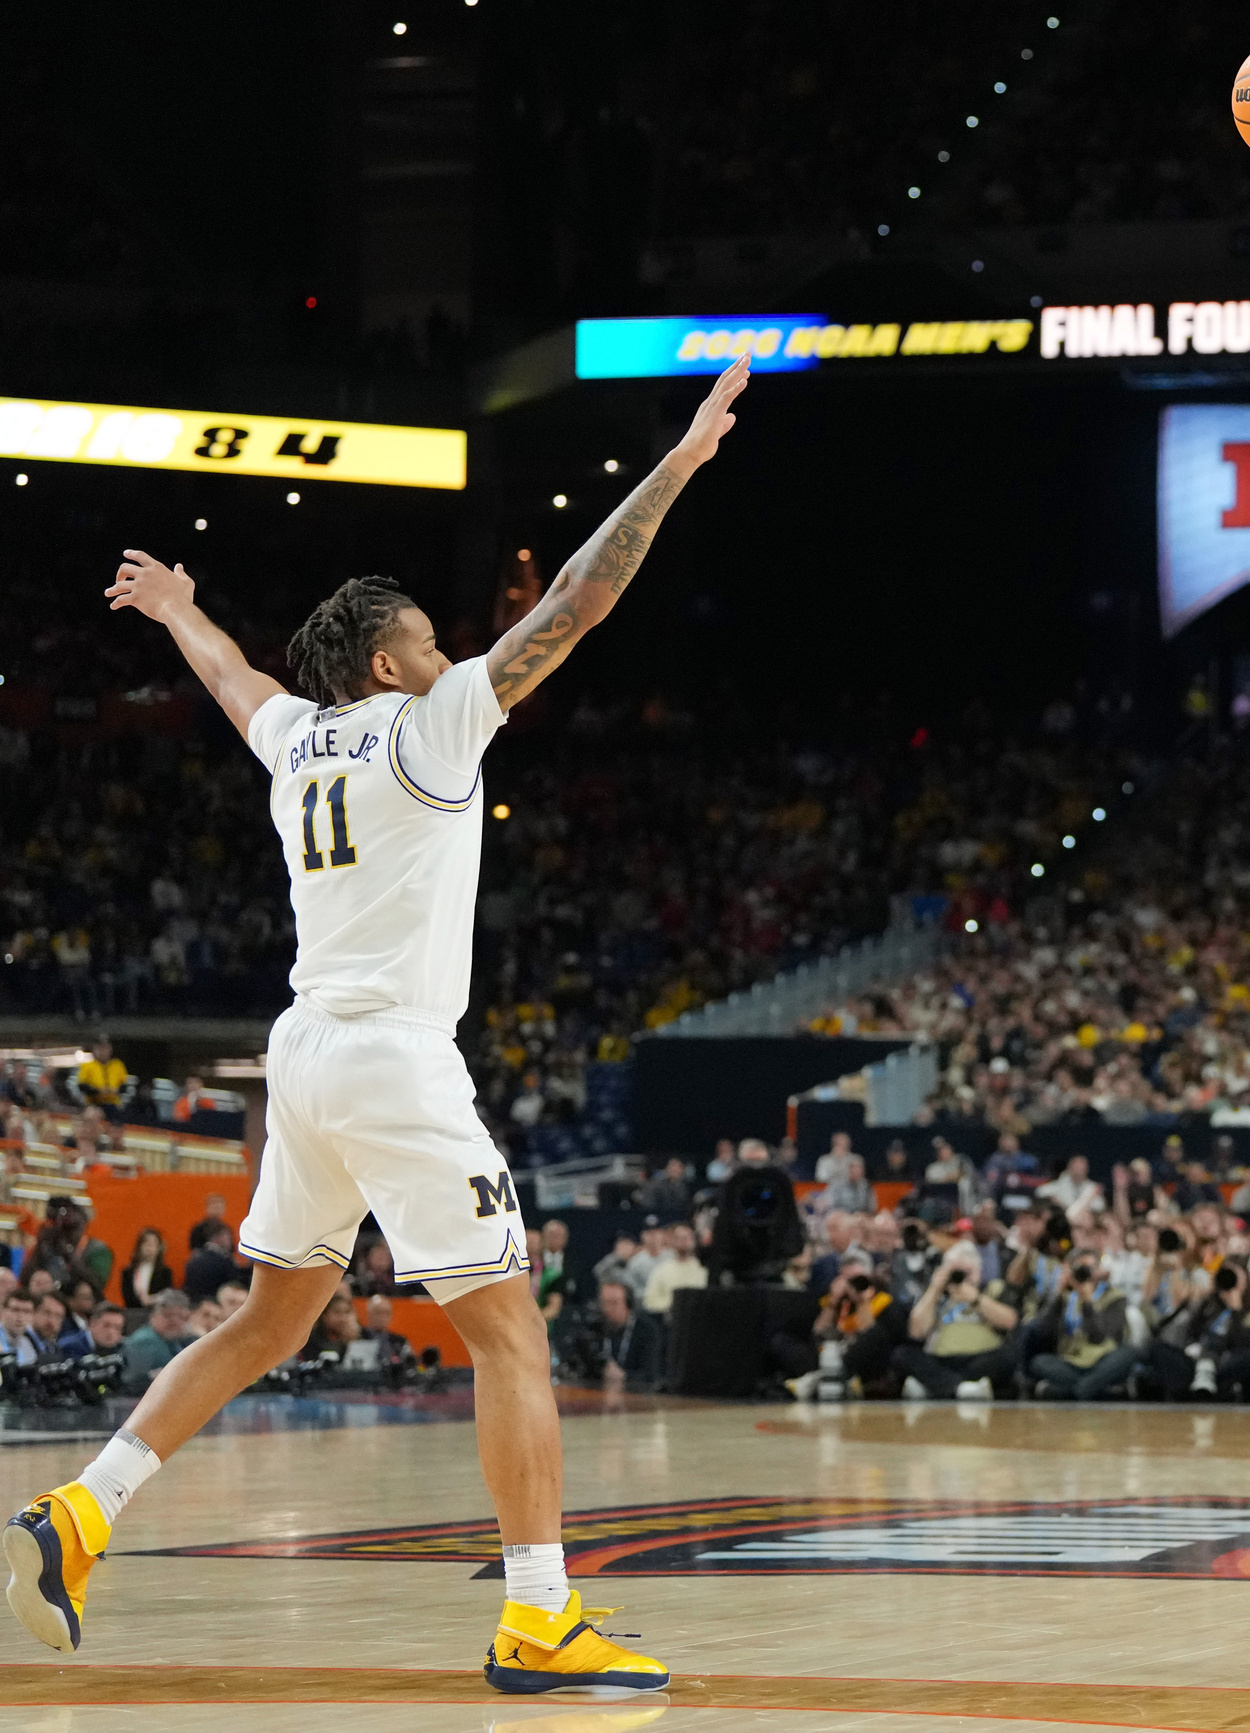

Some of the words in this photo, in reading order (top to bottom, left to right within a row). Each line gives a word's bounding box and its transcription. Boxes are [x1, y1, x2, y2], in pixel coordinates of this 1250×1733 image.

[1040, 304, 1164, 359] FINAL
[301, 774, 358, 873] 11
[467, 1170, 517, 1219] M
